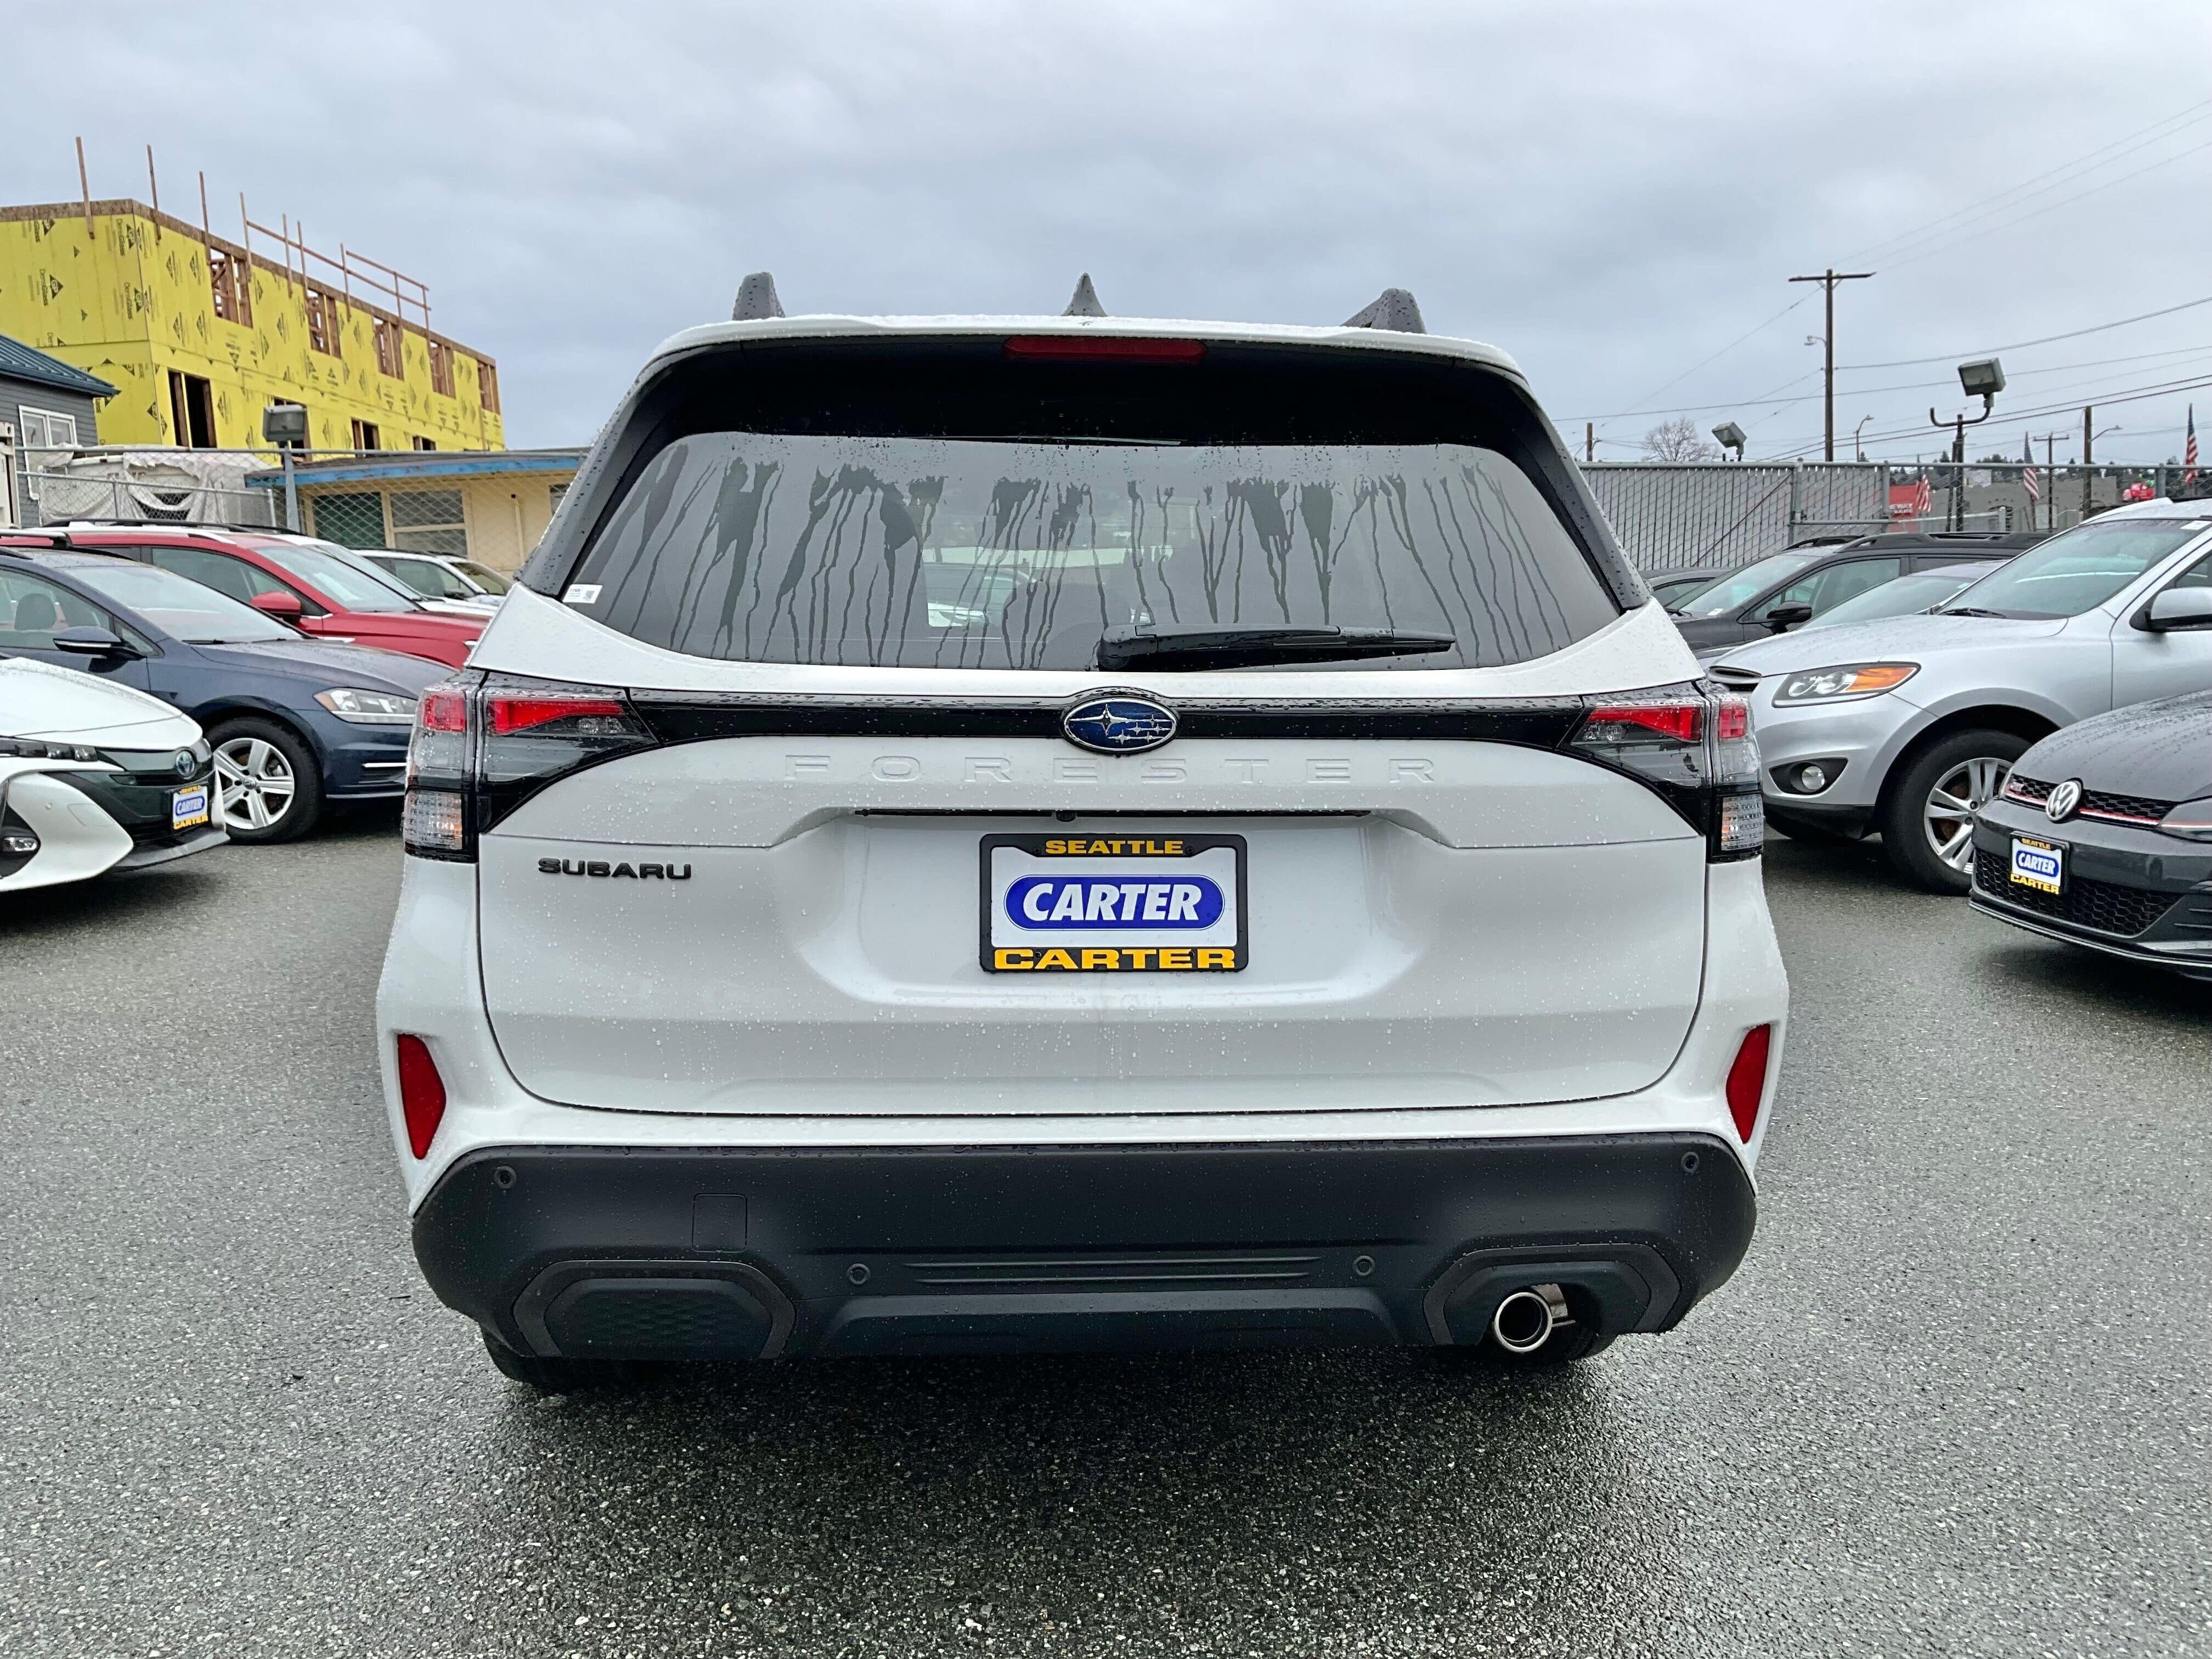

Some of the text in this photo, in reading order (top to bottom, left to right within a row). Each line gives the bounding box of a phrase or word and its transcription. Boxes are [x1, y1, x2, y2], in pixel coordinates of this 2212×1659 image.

[39, 268, 49, 306] DensGlass
[50, 279, 59, 294] GP
[785, 755, 1435, 783] FORESTER
[1045, 840, 1184, 854] SEATTLE
[2021, 838, 2051, 850] SEATTLE
[538, 857, 692, 879] SUBARU
[2018, 853, 2056, 874] CARTER
[2011, 873, 2059, 895] CARTER
[1023, 883, 1203, 921] CARTER
[994, 949, 1235, 969] CARTER
